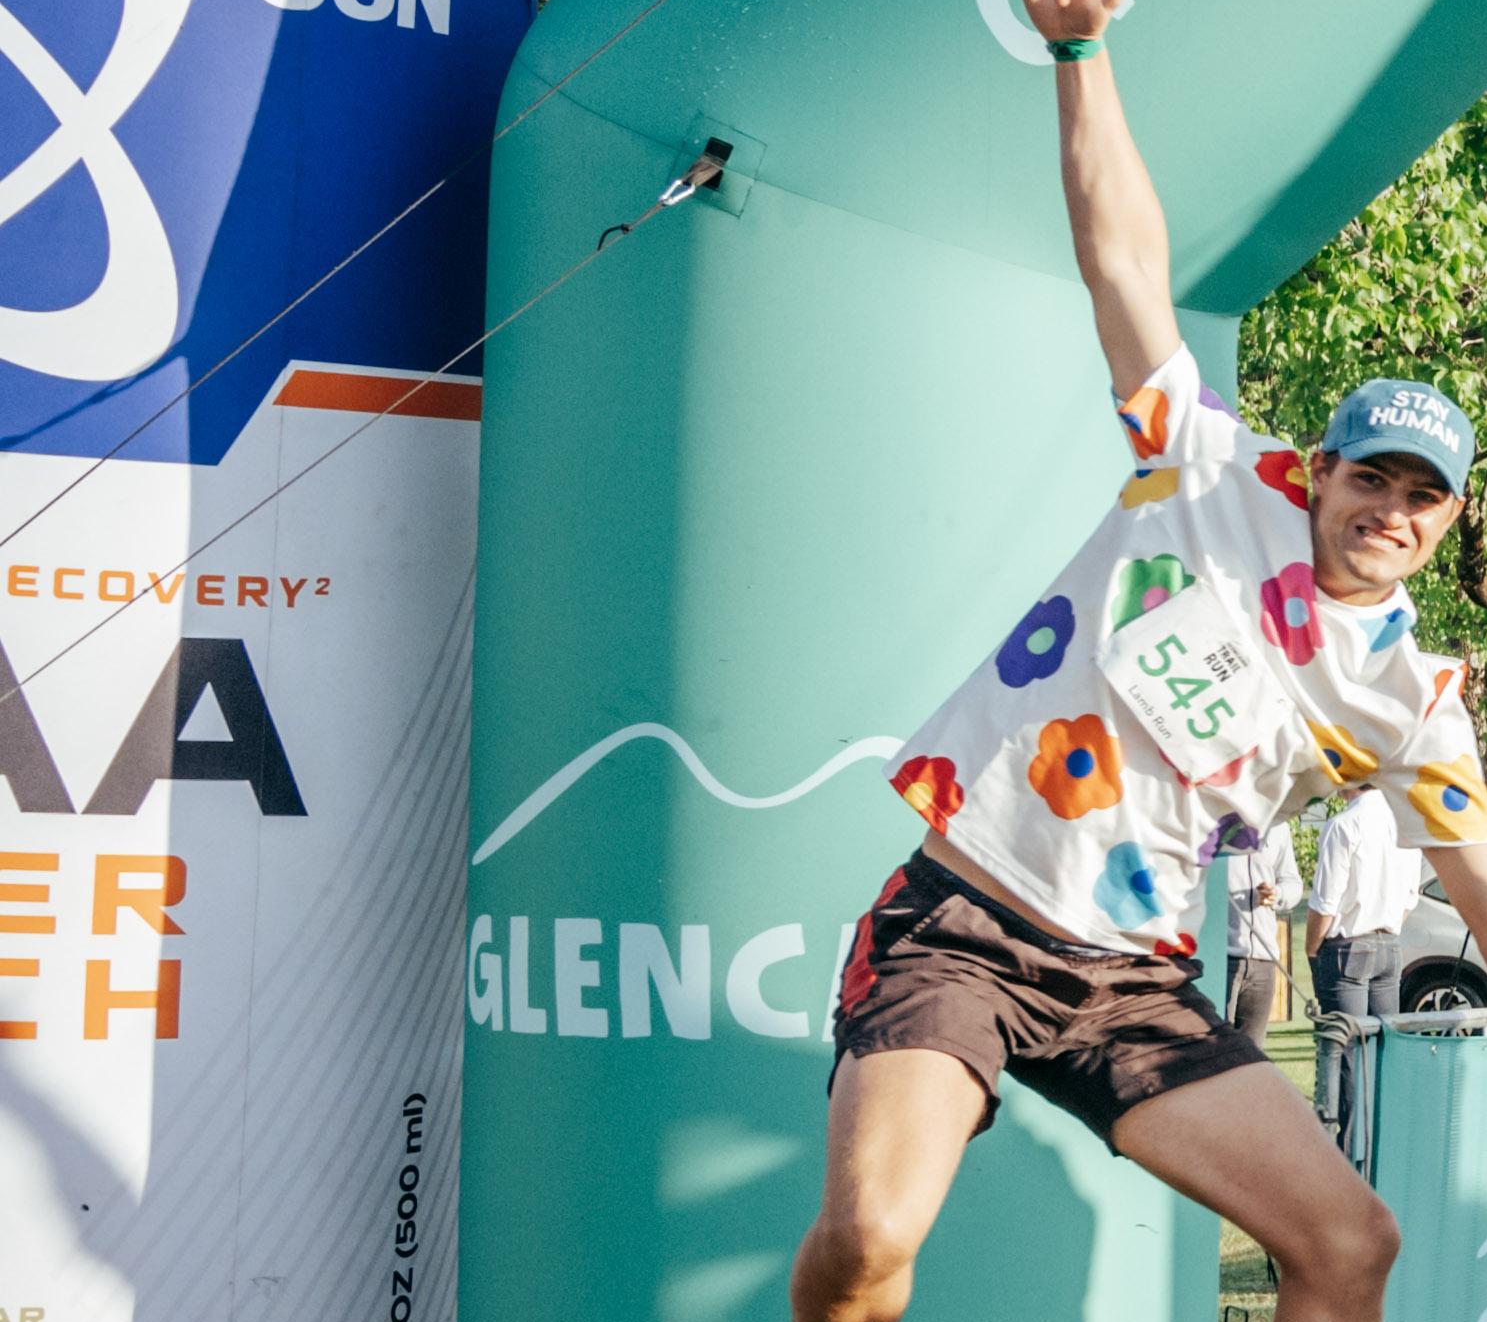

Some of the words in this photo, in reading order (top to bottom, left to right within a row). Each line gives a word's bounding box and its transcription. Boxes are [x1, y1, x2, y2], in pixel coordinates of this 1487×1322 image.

[1369, 406, 1460, 453] HUMAN
[1391, 390, 1450, 422] STAY
[1203, 653, 1232, 682] RUN
[1217, 645, 1241, 674] TRAIL
[1128, 684, 1155, 716] Lamb
[1152, 716, 1173, 739] Run
[1138, 634, 1236, 740] 545
[403, 1093, 427, 1155] ml)
[394, 1164, 420, 1259] (500
